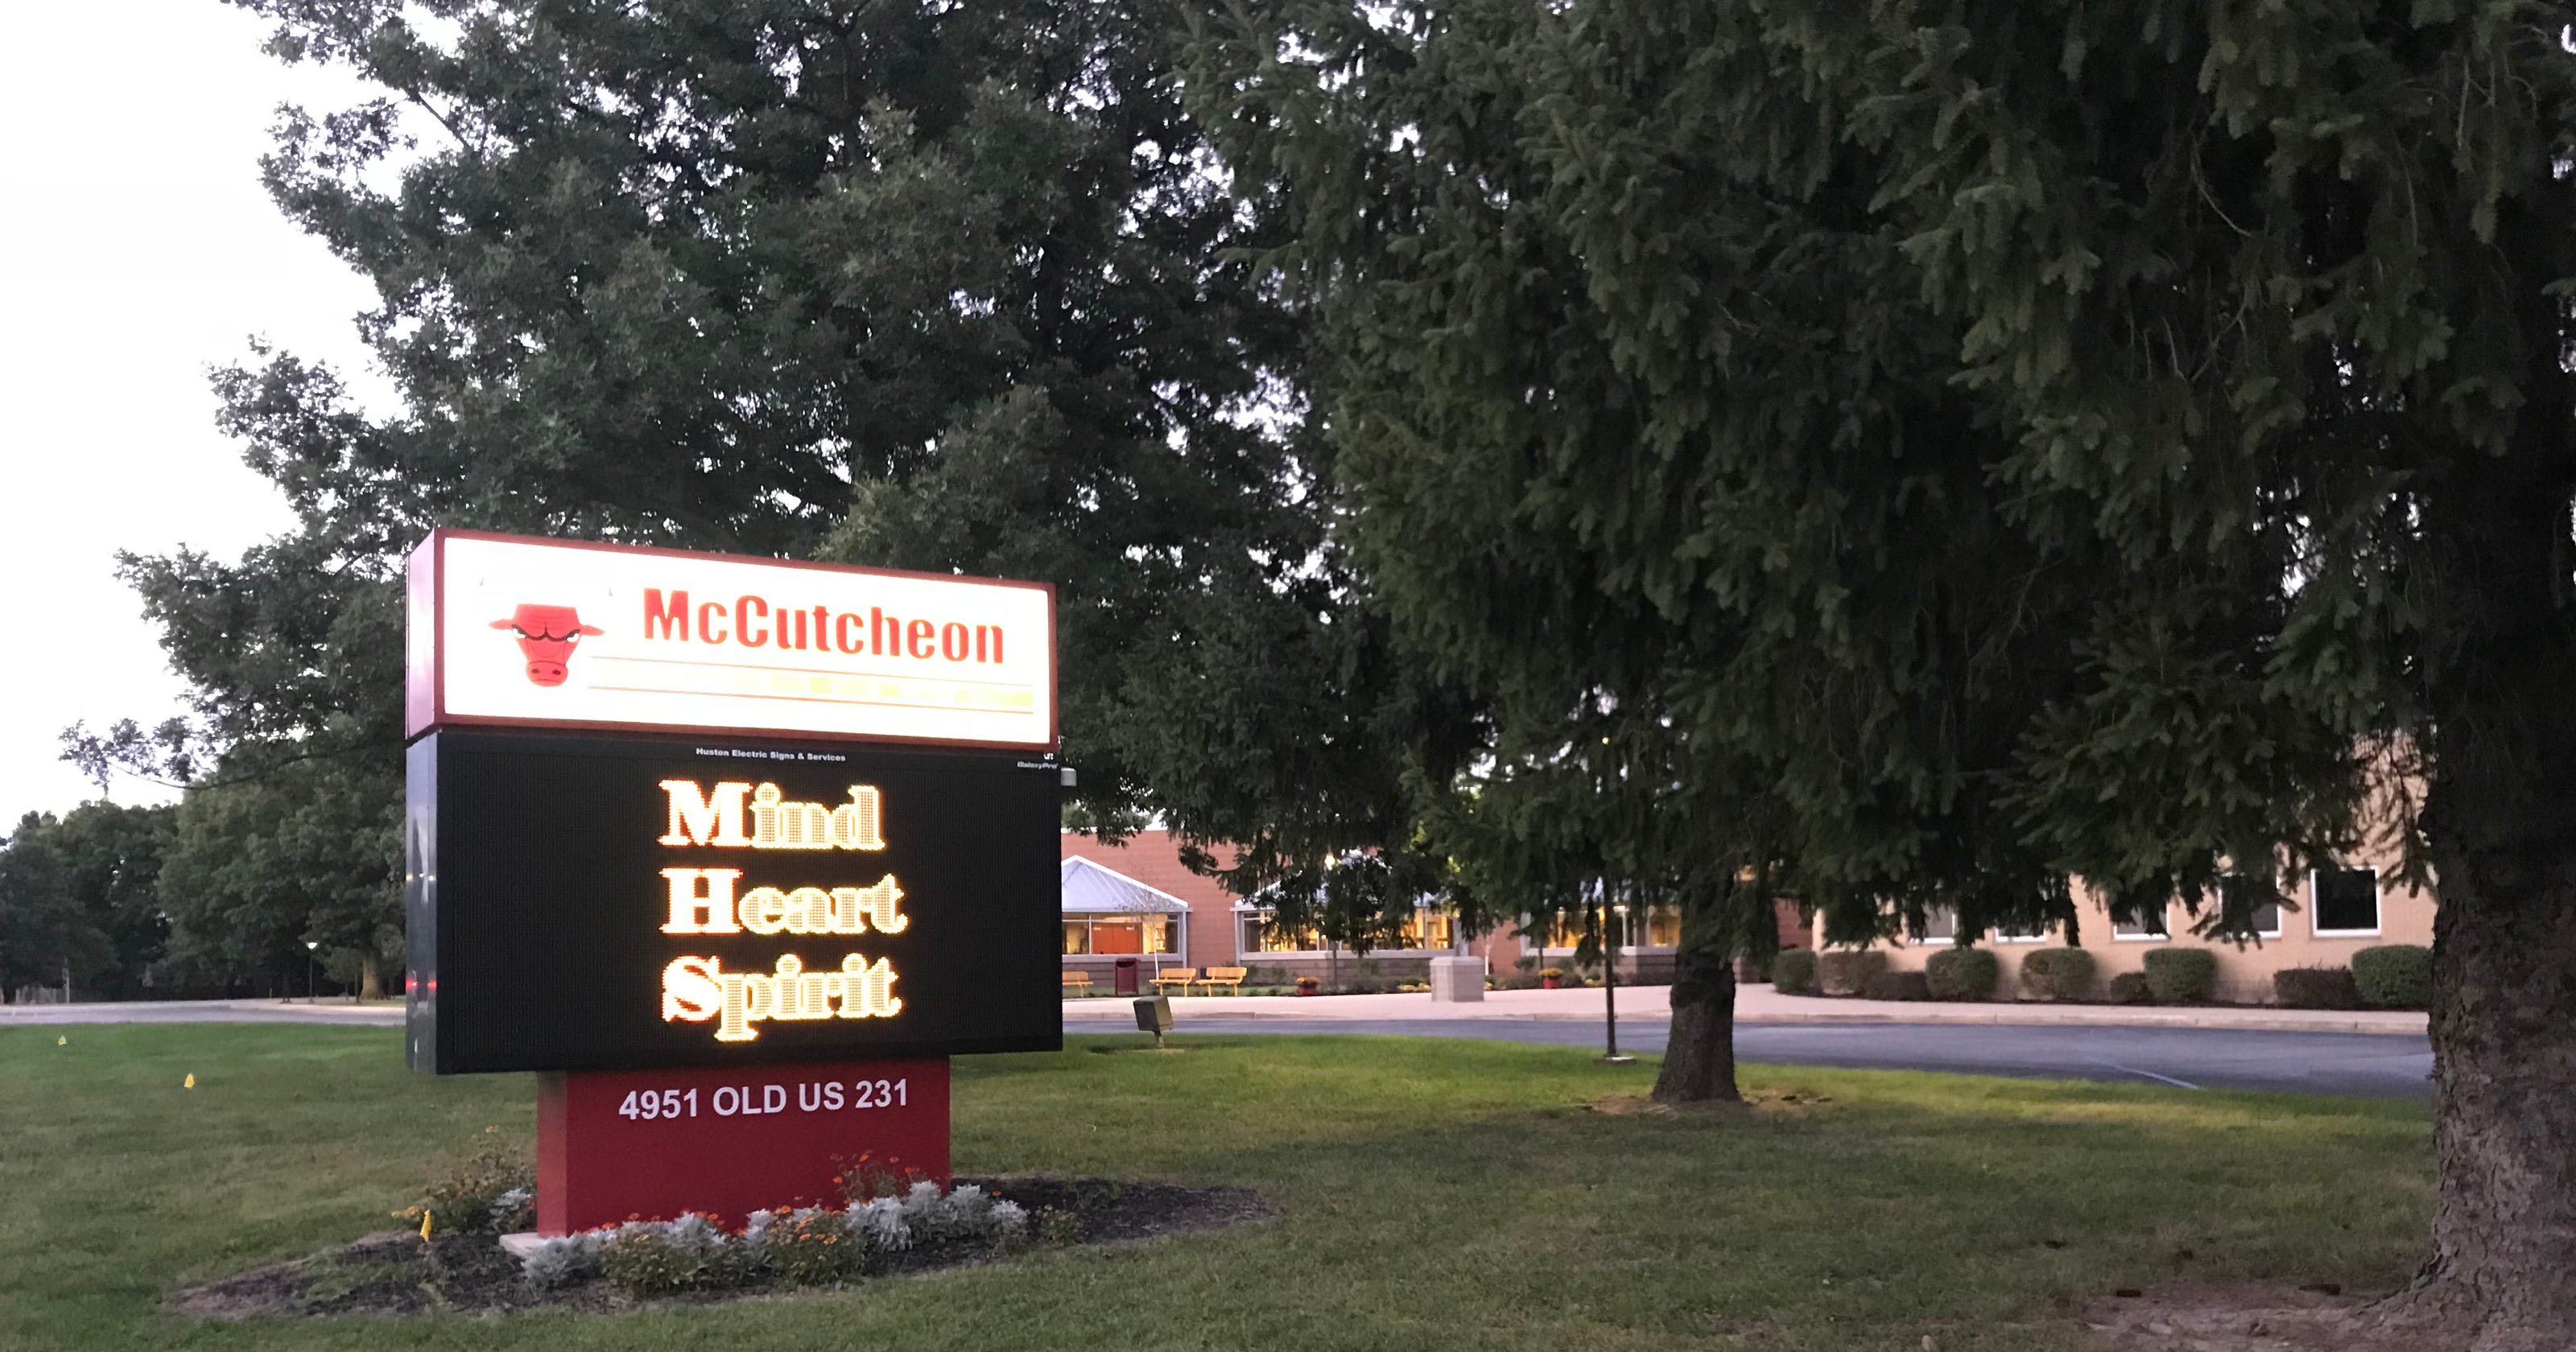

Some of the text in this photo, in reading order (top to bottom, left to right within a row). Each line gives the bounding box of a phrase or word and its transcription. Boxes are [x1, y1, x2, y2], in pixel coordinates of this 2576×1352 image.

[644, 587, 1004, 664] McCutcheon
[696, 748, 729, 756] Huston
[732, 749, 767, 758] Electric
[770, 751, 795, 760] Signs
[807, 753, 846, 761] Services
[658, 779, 886, 851] Mind
[658, 867, 909, 935] Heart
[661, 953, 902, 1041] Spirit
[618, 1078, 906, 1119] 4951 OLD US 231
